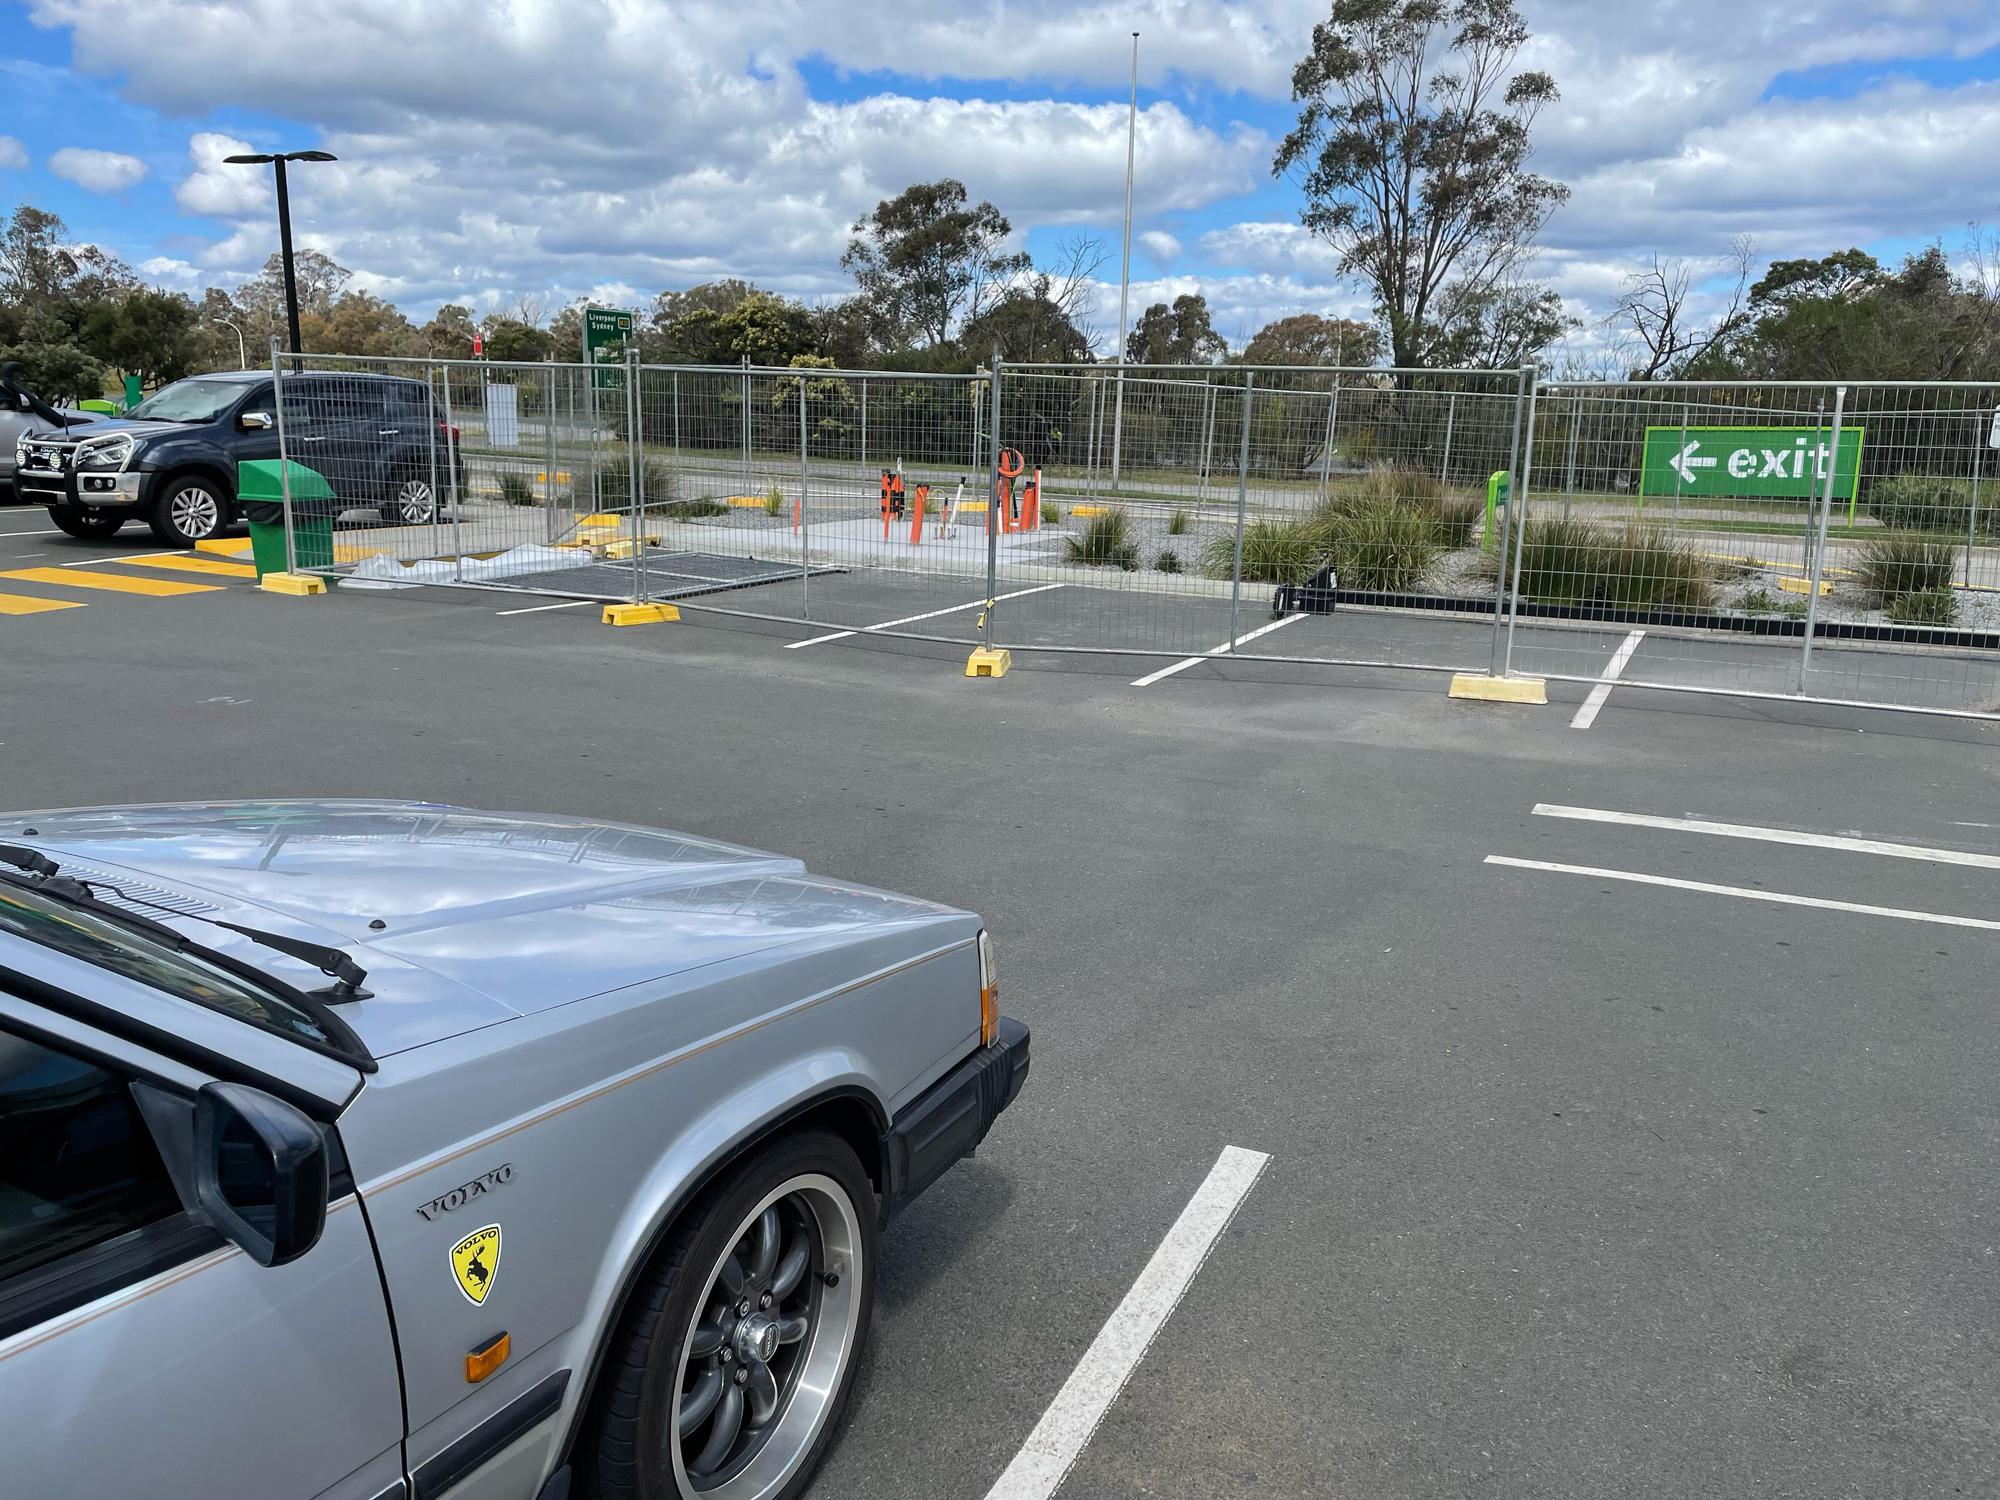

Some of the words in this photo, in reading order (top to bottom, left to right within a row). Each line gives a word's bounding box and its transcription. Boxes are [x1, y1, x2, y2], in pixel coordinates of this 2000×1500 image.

[589, 313, 616, 323] Liverpool
[592, 321, 614, 331] Sydney
[1727, 437, 1831, 479] exit
[416, 1162, 513, 1221] VOLVO
[455, 1230, 497, 1255] VOLVO
